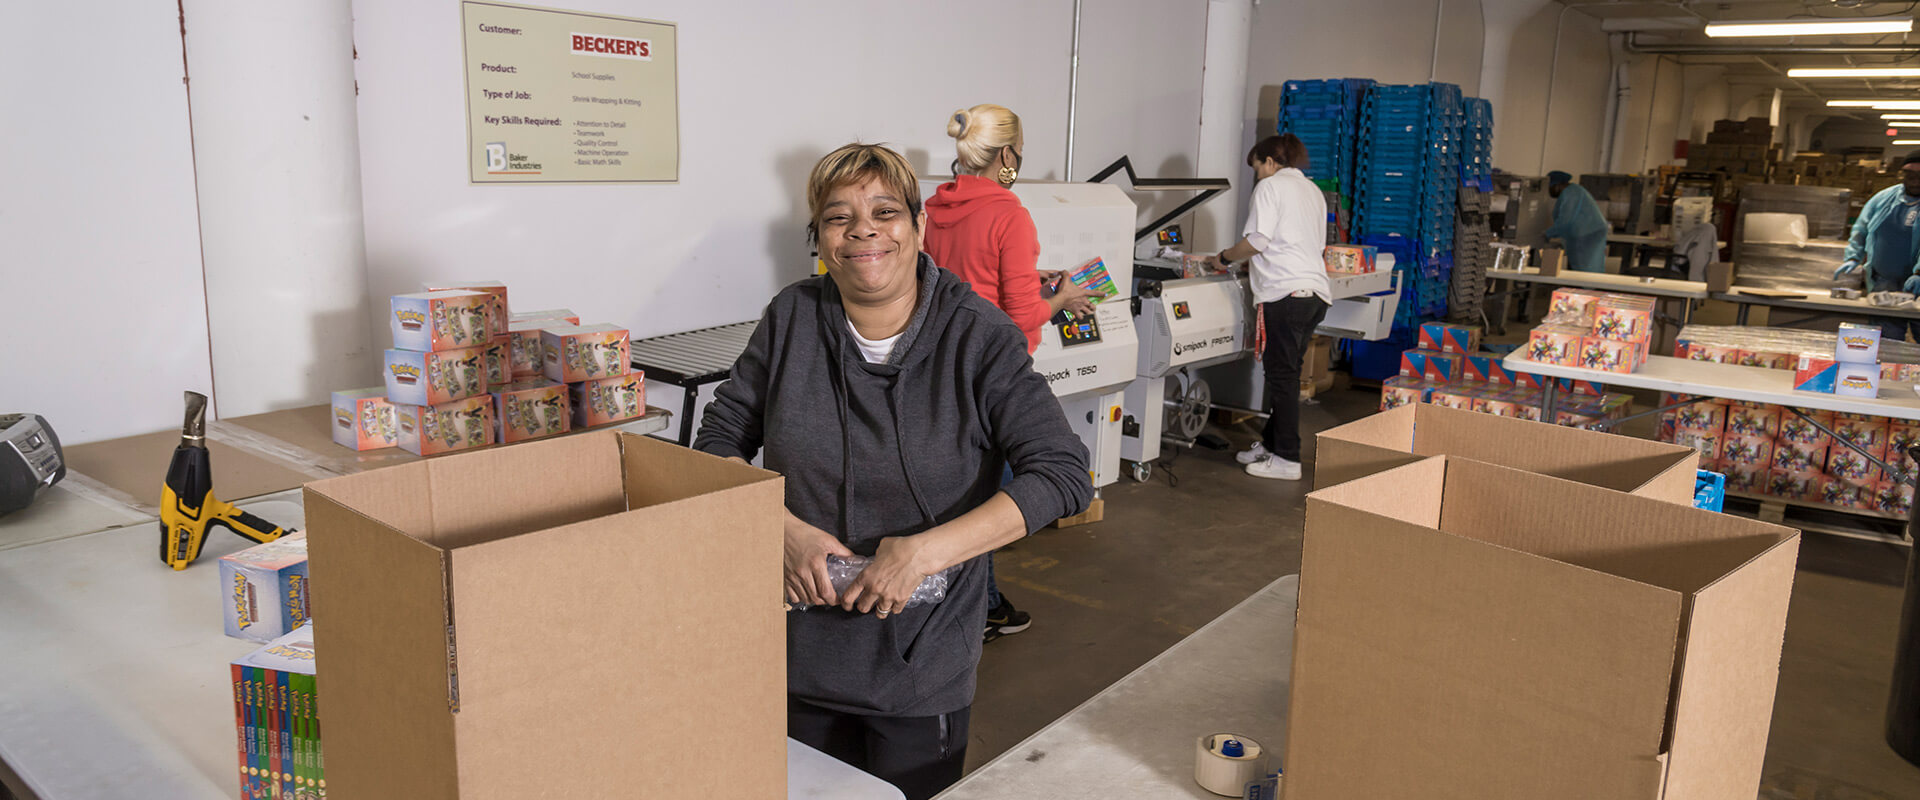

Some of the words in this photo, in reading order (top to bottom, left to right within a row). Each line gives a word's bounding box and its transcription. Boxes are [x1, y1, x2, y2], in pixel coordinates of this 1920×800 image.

[479, 23, 523, 36] Customer:
[572, 34, 649, 57] BECKER'S
[481, 62, 518, 74] Product:
[571, 71, 591, 79] School
[592, 73, 616, 81] Supplies
[483, 88, 503, 100] Type
[505, 90, 514, 99] of
[515, 91, 532, 100] Job:
[572, 95, 590, 103] Shrink
[591, 97, 618, 106] Wrapping
[624, 98, 642, 107] Kitting
[485, 115, 500, 126] Key
[502, 116, 523, 125] Skills
[524, 116, 562, 127] Required:
[577, 139, 597, 147] Quality
[598, 139, 618, 147] Control
[509, 153, 528, 162] Baker
[509, 162, 542, 170] Industries
[1076, 364, 1098, 376] T650
